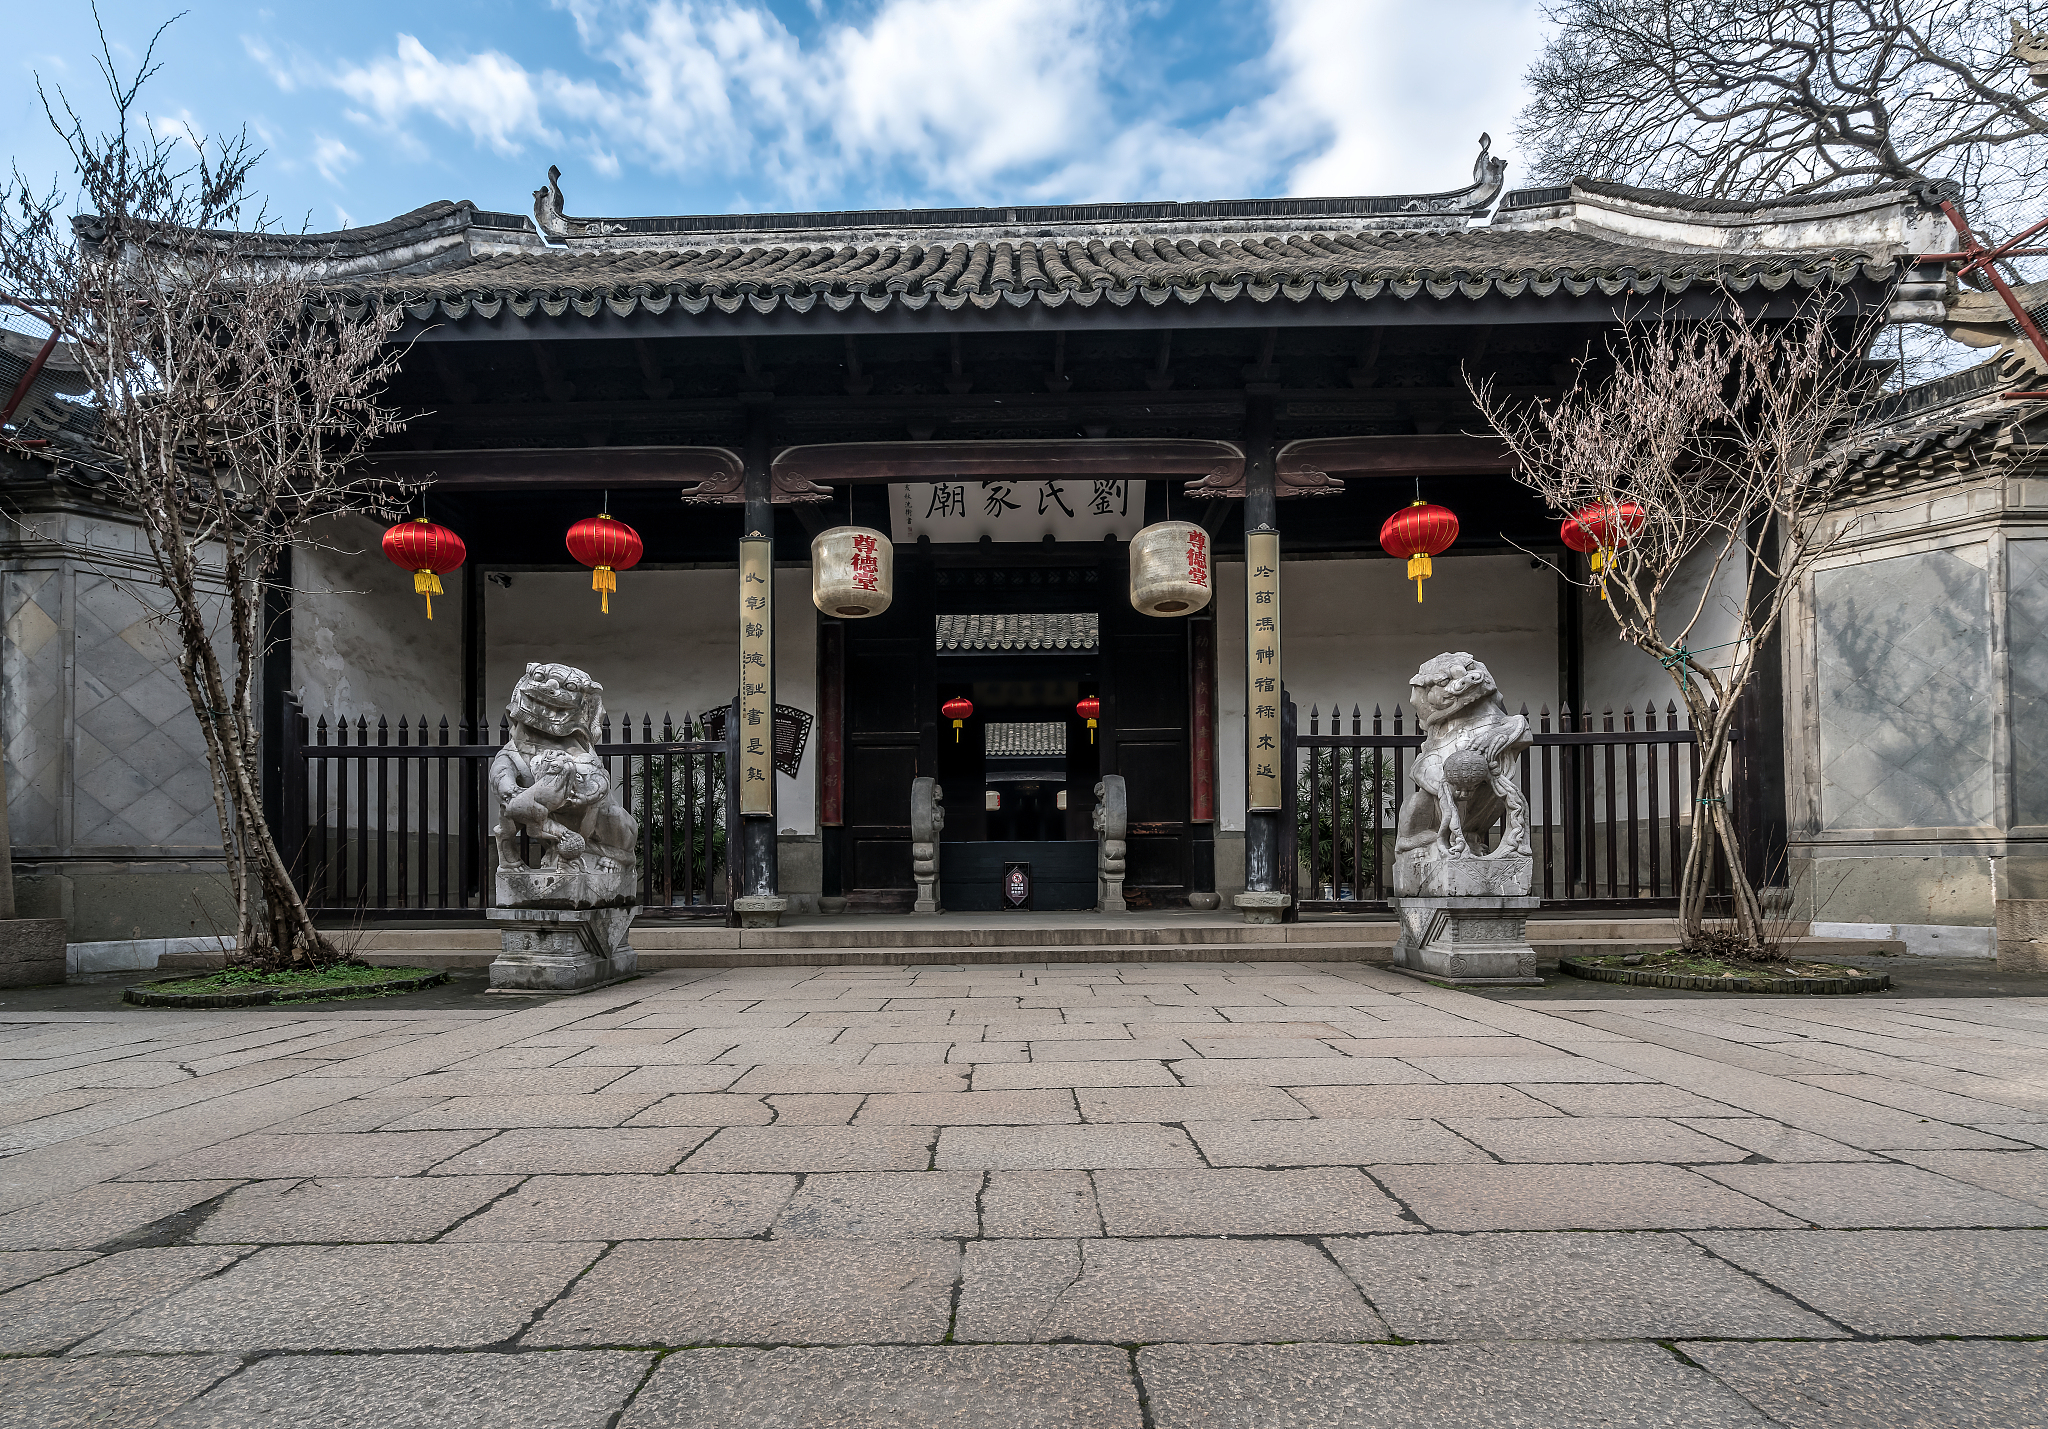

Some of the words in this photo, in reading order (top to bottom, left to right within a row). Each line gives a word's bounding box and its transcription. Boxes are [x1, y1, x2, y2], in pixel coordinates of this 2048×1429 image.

[850, 534, 879, 592] 尊德堂
[1186, 530, 1208, 588] 尊德堂
